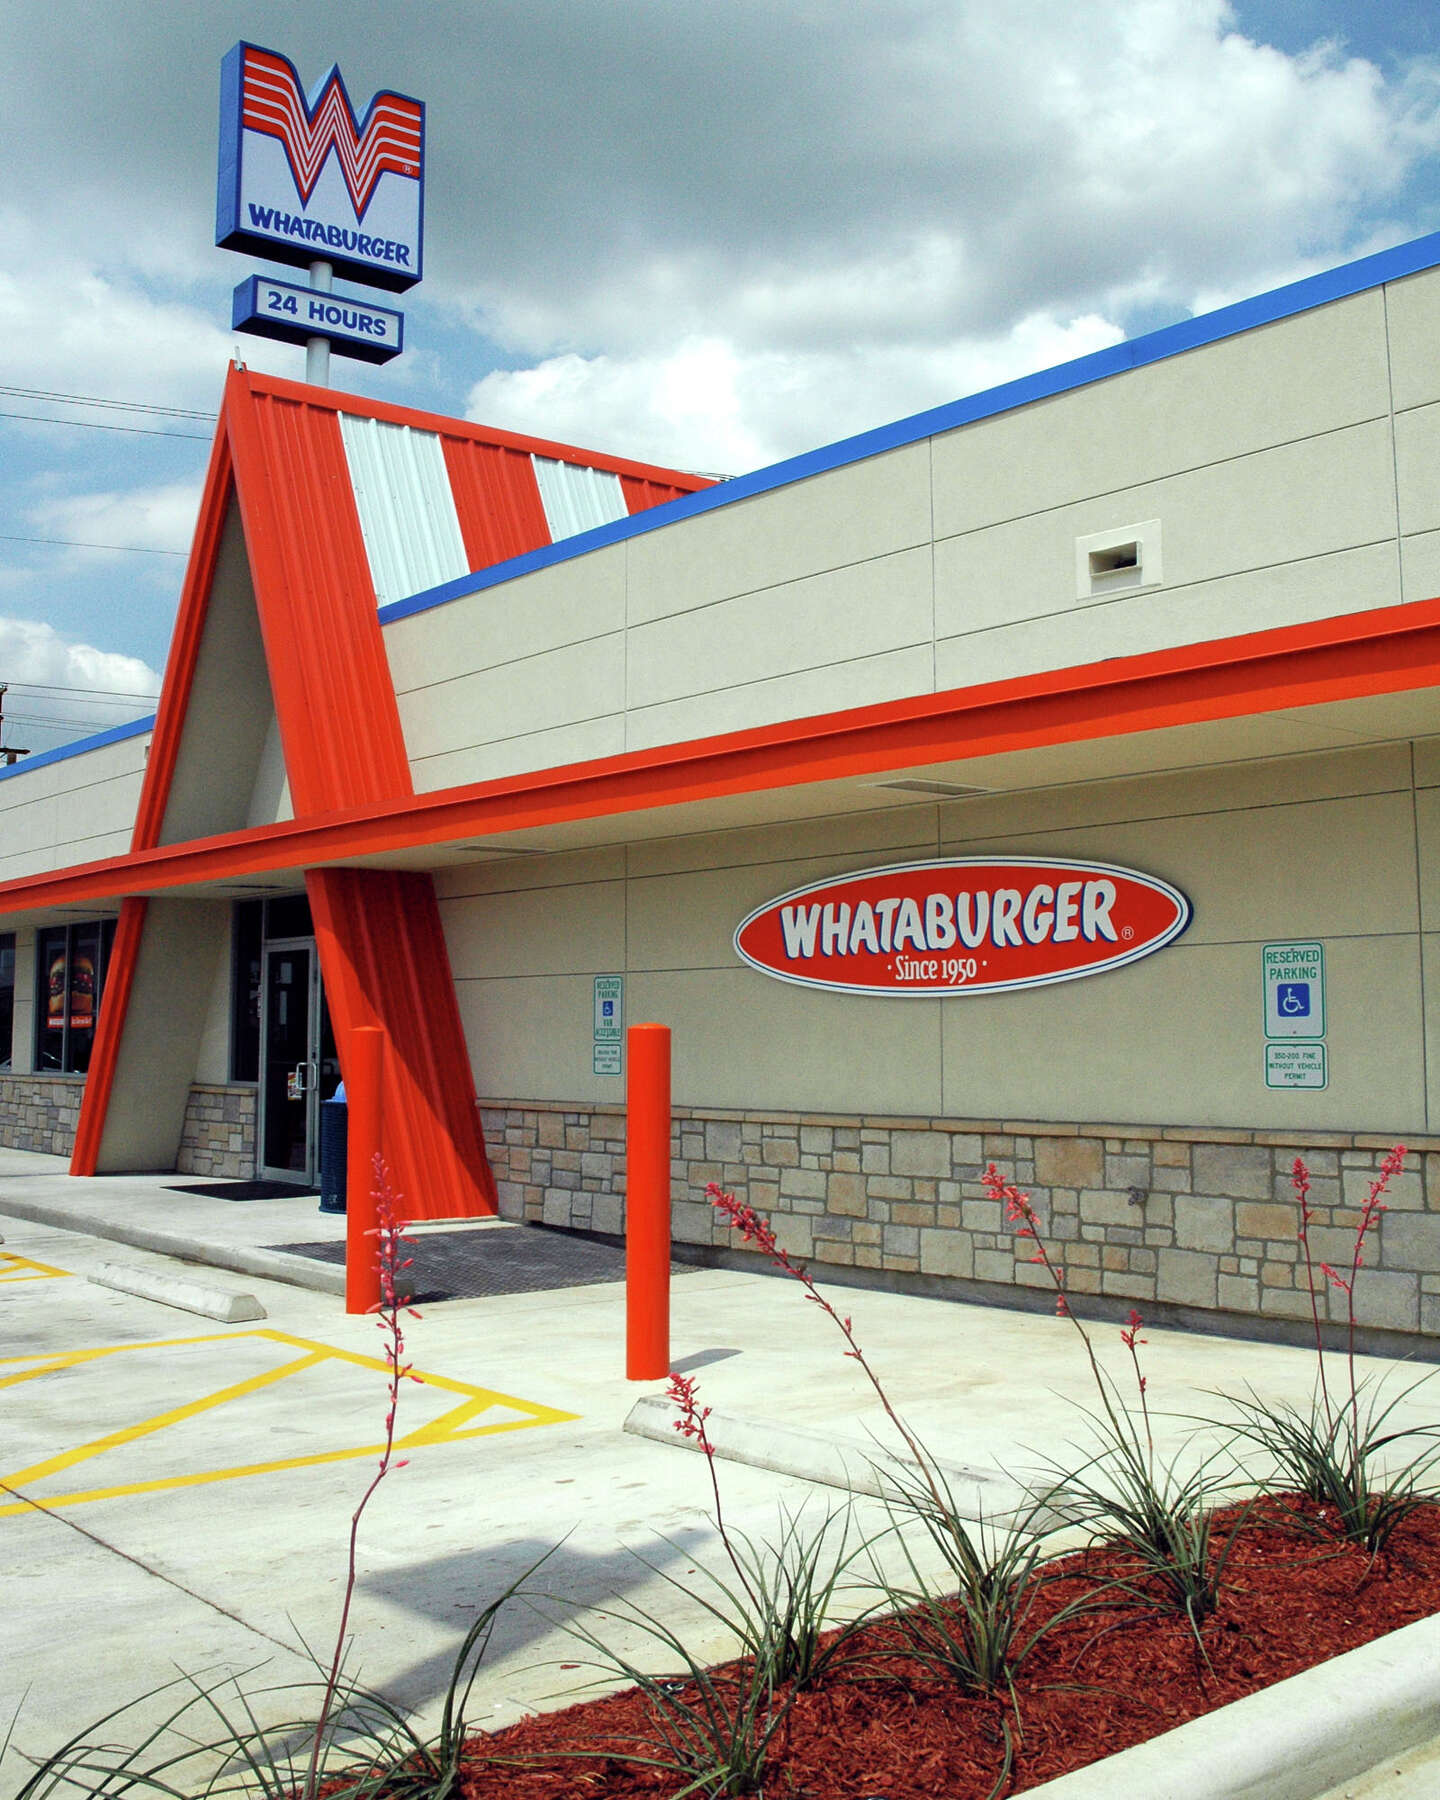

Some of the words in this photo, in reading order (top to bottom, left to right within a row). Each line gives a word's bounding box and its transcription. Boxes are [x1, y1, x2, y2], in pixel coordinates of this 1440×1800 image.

[248, 202, 411, 267] WHATABURGER
[267, 291, 298, 315] 24
[308, 300, 386, 337] HOURS
[780, 879, 1118, 960] WHATABURGER
[895, 955, 938, 981] Since
[941, 958, 977, 985] 1950
[1266, 950, 1320, 964] RESERVED
[1269, 966, 1317, 980] PARKING
[1269, 1062, 1294, 1070] WITHOUT
[1297, 1063, 1321, 1071] VEHICLE
